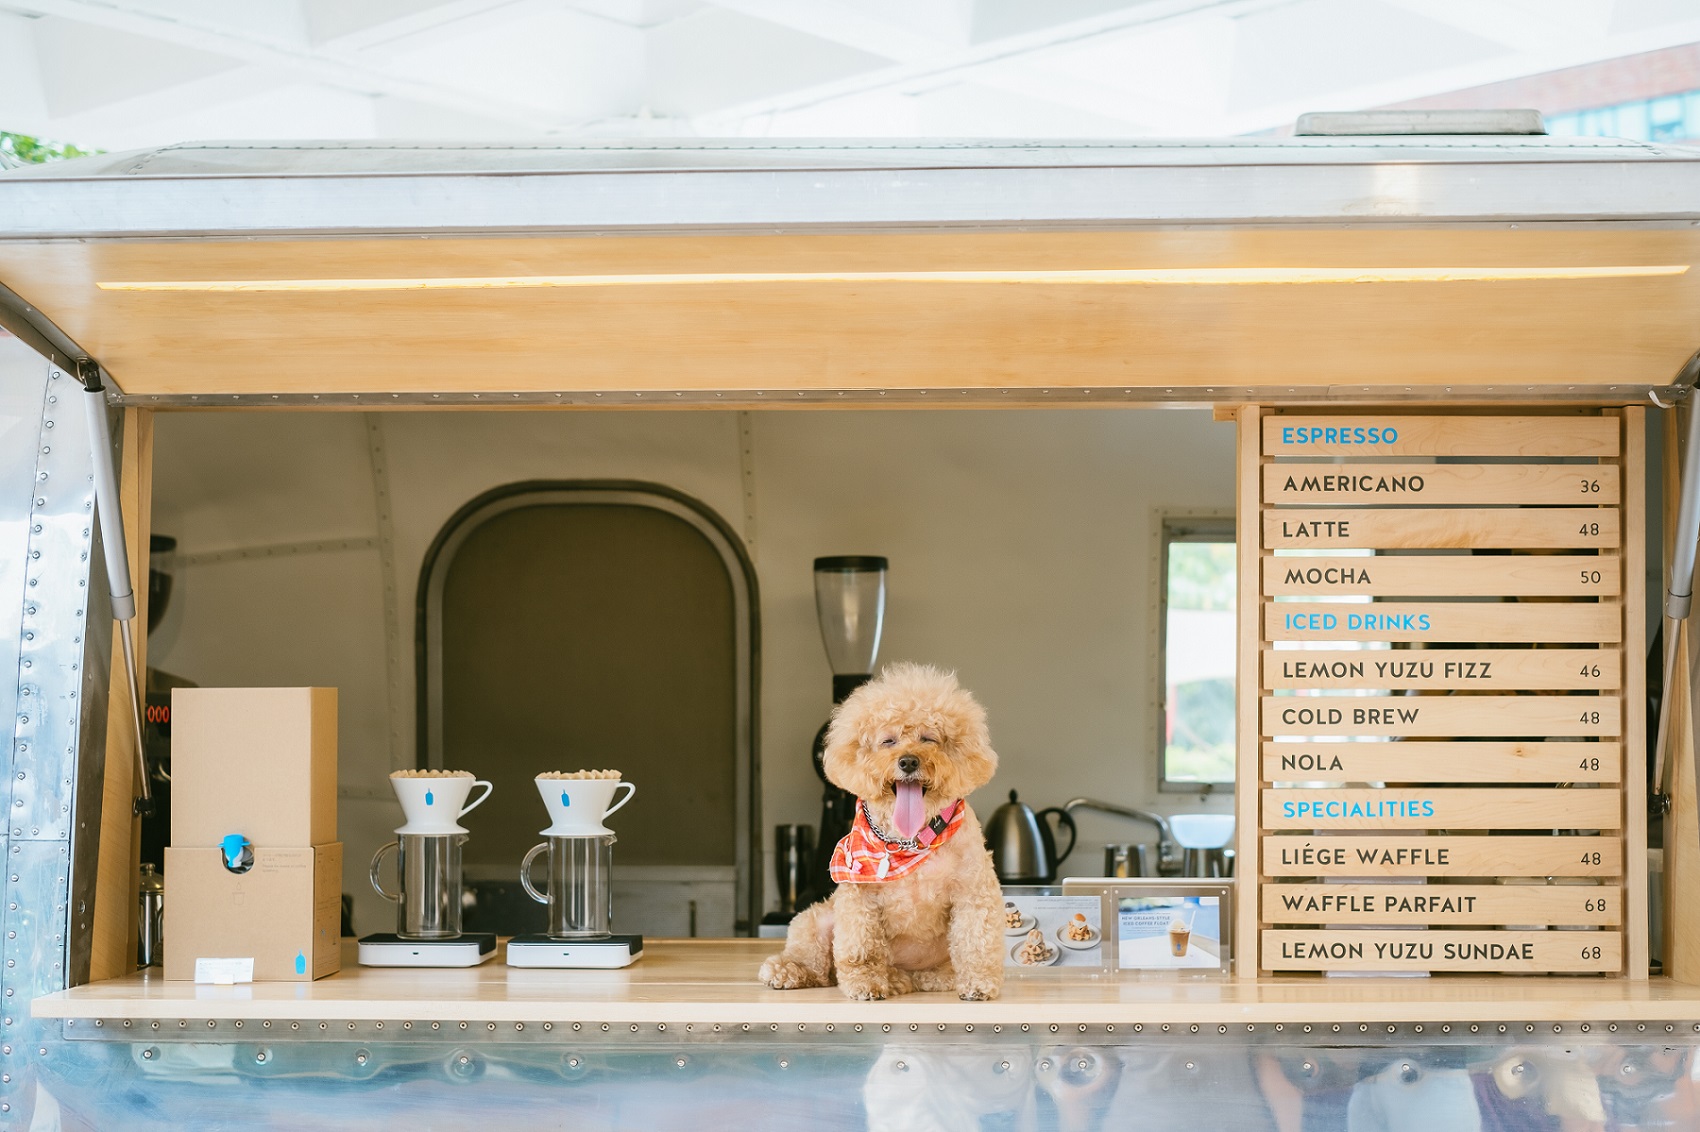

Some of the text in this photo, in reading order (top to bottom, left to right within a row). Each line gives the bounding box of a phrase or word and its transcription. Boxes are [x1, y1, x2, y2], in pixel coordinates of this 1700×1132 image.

[1282, 427, 1398, 444] ESPRESSO
[1283, 475, 1425, 492] AMERICANO
[1580, 479, 1600, 493] 36
[1282, 521, 1350, 538] LATTE
[1579, 522, 1600, 537] 48
[1284, 567, 1372, 585] MOCHA
[1580, 570, 1601, 584] 50
[1285, 613, 1431, 630] ICED DRINKS
[1283, 661, 1492, 679] LEMON YUZU FIZZ
[1579, 664, 1601, 678] 46
[1282, 708, 1420, 725] COLD BREW
[1579, 711, 1600, 725] 48
[1281, 754, 1344, 771] NOLA
[1579, 757, 1600, 772] 48
[1282, 800, 1434, 818] SPECIALITIES
[1282, 842, 1450, 866] LIÉGE WAFFLE
[1580, 851, 1601, 866] 48
[1281, 895, 1477, 913] WAFFLE PARFAIT
[1584, 898, 1607, 913] 68
[1282, 942, 1534, 960] LEMON YUZU SUNDAE
[1581, 946, 1601, 960] 68
